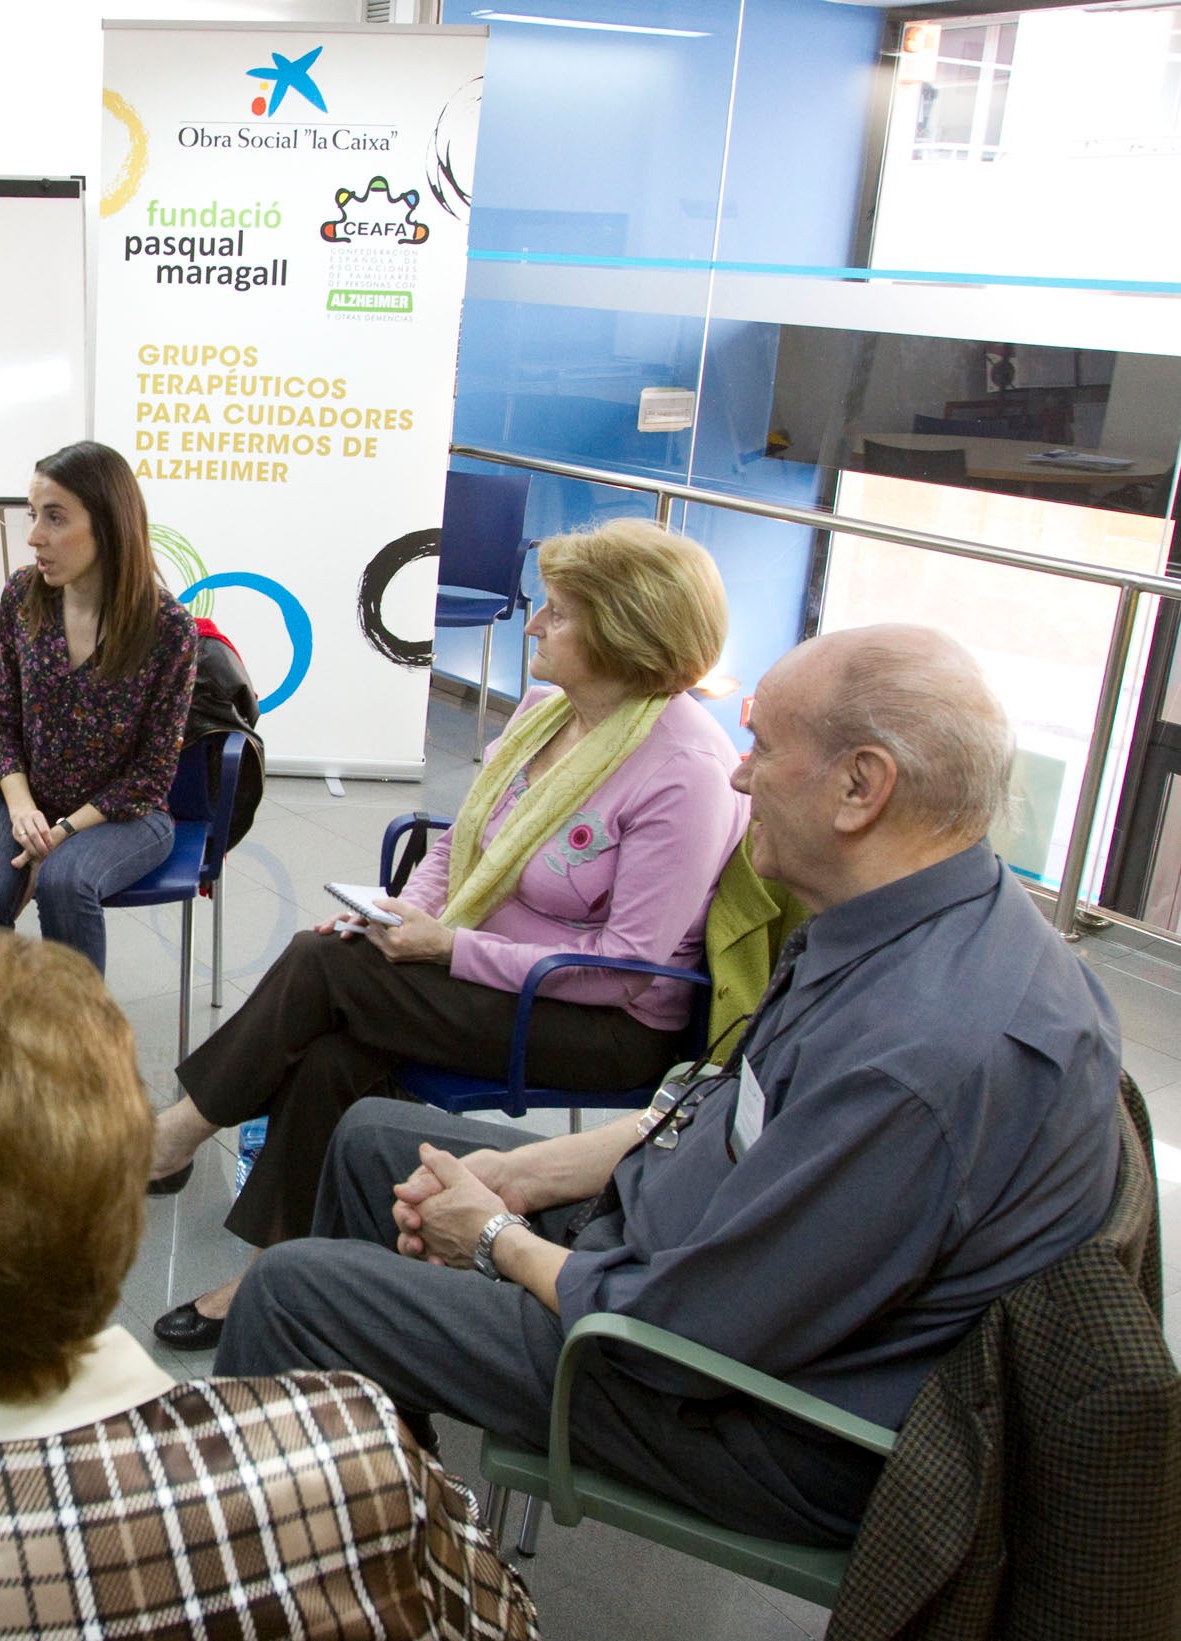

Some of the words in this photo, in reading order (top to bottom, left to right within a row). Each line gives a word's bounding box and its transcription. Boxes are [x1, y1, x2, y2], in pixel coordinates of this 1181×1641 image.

[178, 126, 232, 148] Obra
[238, 127, 299, 149] Social
[147, 199, 283, 229] fundació
[343, 221, 407, 237] CEAFA
[125, 229, 244, 263] pasqual
[330, 247, 419, 256] CONFEDERACIÓN
[328, 264, 418, 273] ASOCIACIONES
[404, 257, 418, 265] DE
[156, 258, 287, 292] maragall
[327, 279, 340, 287] DE
[344, 280, 391, 289] PERSONAS
[394, 281, 416, 289] CON
[328, 271, 341, 279] DE
[349, 272, 417, 281] FAMILIARES
[330, 292, 409, 309] ALZHEIMER
[334, 313, 361, 321] OTRAS
[364, 313, 413, 322] DEMENCIAS
[138, 343, 259, 368] GRUPOS
[136, 368, 347, 400] TERAPÉUTICOS
[136, 402, 212, 424] PARA
[223, 403, 414, 431] CUIDADORES
[135, 430, 170, 452] DE
[181, 431, 332, 457] ENFERMOS
[342, 435, 379, 458] DE
[135, 458, 289, 484] ALZHEIMER
